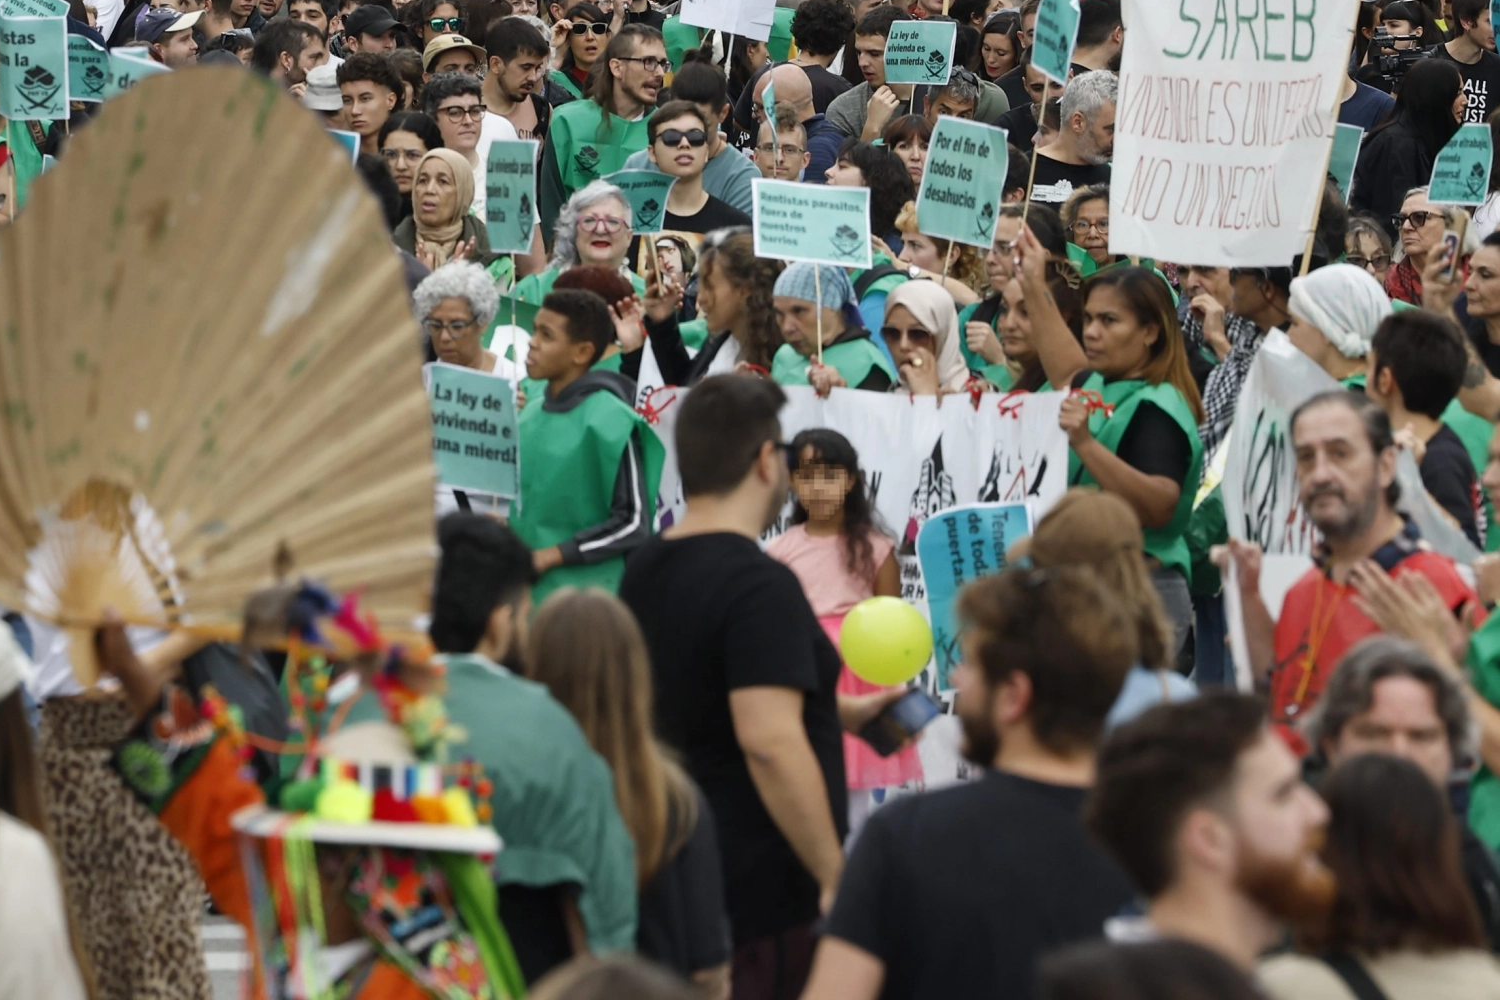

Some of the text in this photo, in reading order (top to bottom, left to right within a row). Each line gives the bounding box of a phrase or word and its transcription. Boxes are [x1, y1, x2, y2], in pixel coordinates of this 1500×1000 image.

[27, 6, 39, 16] no
[890, 31, 919, 43] La ley de
[887, 44, 916, 53] vivienda
[15, 55, 29, 67] la
[81, 56, 100, 65] para
[886, 56, 924, 66] una mierda
[1205, 81, 1241, 147] ES
[935, 131, 990, 158] Por el fin de
[495, 161, 533, 177] vivienda para
[930, 159, 972, 180] todos los
[924, 183, 976, 209] desahucios
[1122, 155, 1172, 221] NO
[1174, 162, 1209, 226] UN
[760, 192, 809, 208] Rentistas
[760, 206, 803, 220] fuera de
[761, 222, 807, 234] nuestros
[761, 234, 798, 246] barrios
[434, 384, 502, 412] La ley de
[432, 408, 498, 437] vivienda
[968, 511, 983, 534] de
